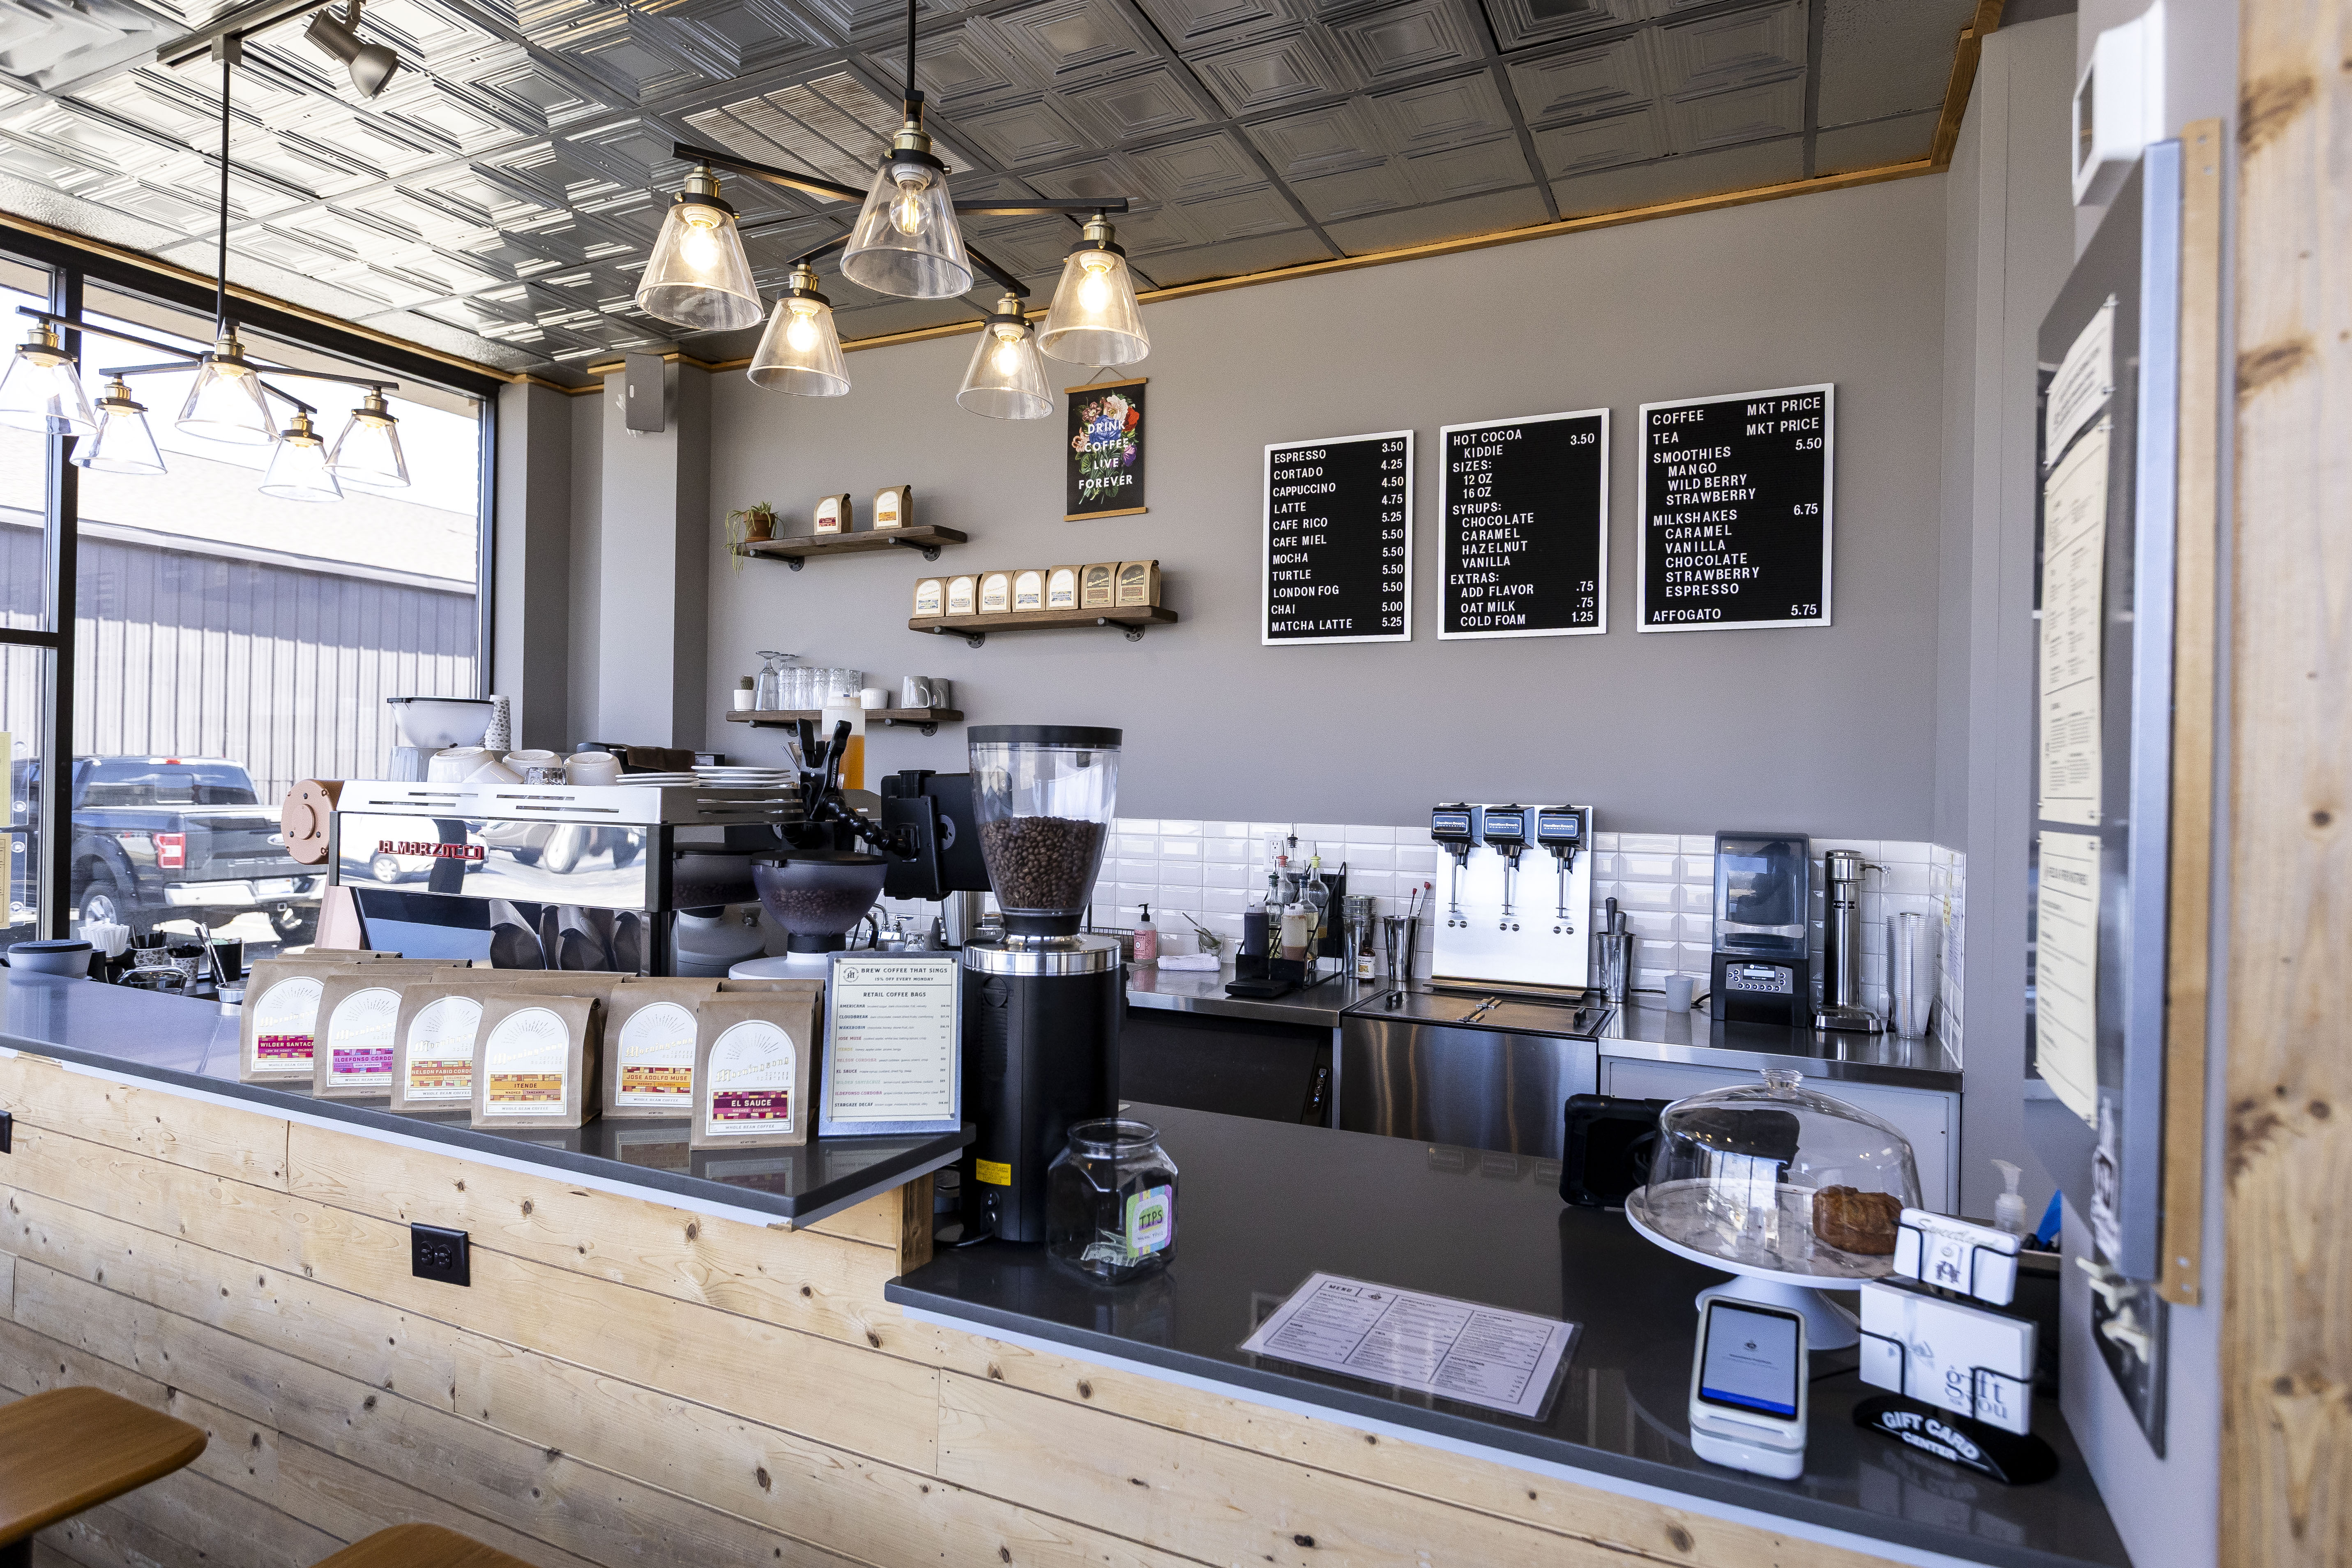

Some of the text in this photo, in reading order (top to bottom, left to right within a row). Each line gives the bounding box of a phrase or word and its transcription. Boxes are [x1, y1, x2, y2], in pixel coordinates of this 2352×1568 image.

[1653, 397, 1820, 425] COFFEE MKT PRICE
[1088, 419, 1125, 434] DRINK
[1653, 417, 1818, 444] TEA MKT PRICE
[1085, 438, 1129, 452] COFFEE
[1454, 429, 1594, 445] HOT COCOA 3.50
[1275, 442, 1403, 463] ESPRESSO 3.50
[1465, 445, 1502, 458] KIDDIE
[1654, 438, 1821, 465] SMOOTHIES 5.50
[1094, 458, 1118, 470] LIVE
[1274, 459, 1402, 480] CORTADO 4.25
[1453, 460, 1491, 472] SIZES:
[1669, 463, 1716, 477] MANGO
[1079, 475, 1132, 489] FOREVER
[1273, 477, 1403, 496] CAPPUCCINO 4.50
[1464, 473, 1492, 485] 12 OZ
[1463, 487, 1491, 498] 16 OZ
[1667, 487, 1755, 505] STRAWBERRY
[1275, 494, 1402, 513] LATTE 4.75
[1453, 502, 1501, 515] SYRUPS:
[1273, 511, 1401, 530] CAFE RICO 5.25
[1462, 511, 1534, 527] CHOCOLATE
[1654, 503, 1818, 527] MILKSHAKES 6.75
[1273, 529, 1403, 547] CAFE MIEL 5.50
[1462, 528, 1520, 541] CARAMEL
[1666, 525, 1732, 539] CARAMEL
[1463, 541, 1527, 555] HAZELNUT
[1666, 540, 1725, 553] VANILLA
[1273, 547, 1403, 564] MOCHA 5.50
[1462, 556, 1510, 568] VANILLA
[1666, 553, 1747, 567] CHOCOLATE
[1272, 564, 1403, 580] TURTLE 5.50
[1451, 572, 1498, 584] EXTRAS:
[1666, 567, 1759, 582] STRAWBERRY
[1274, 582, 1403, 597] LONDON FOG 5.50
[1461, 581, 1593, 597] ADD FLAVOR .75
[1666, 583, 1739, 596] ESPRESSO
[1272, 602, 1403, 614] CHAI 5.00
[1461, 597, 1593, 613] OAT MILK .75
[1653, 604, 1816, 621] AFFOGATO 5.75
[1272, 617, 1402, 631] MATCHA LATTE 5.25
[1461, 611, 1593, 626] COLD FOAM 1.25
[624, 1037, 693, 1057] Morningsong
[715, 1057, 789, 1082] Morningsong
[1139, 1210, 1163, 1228] TIPS
[1945, 1365, 2004, 1404] gft
[1882, 1411, 1981, 1460] GIFT CARD
[1901, 1431, 1958, 1462] CENTER
